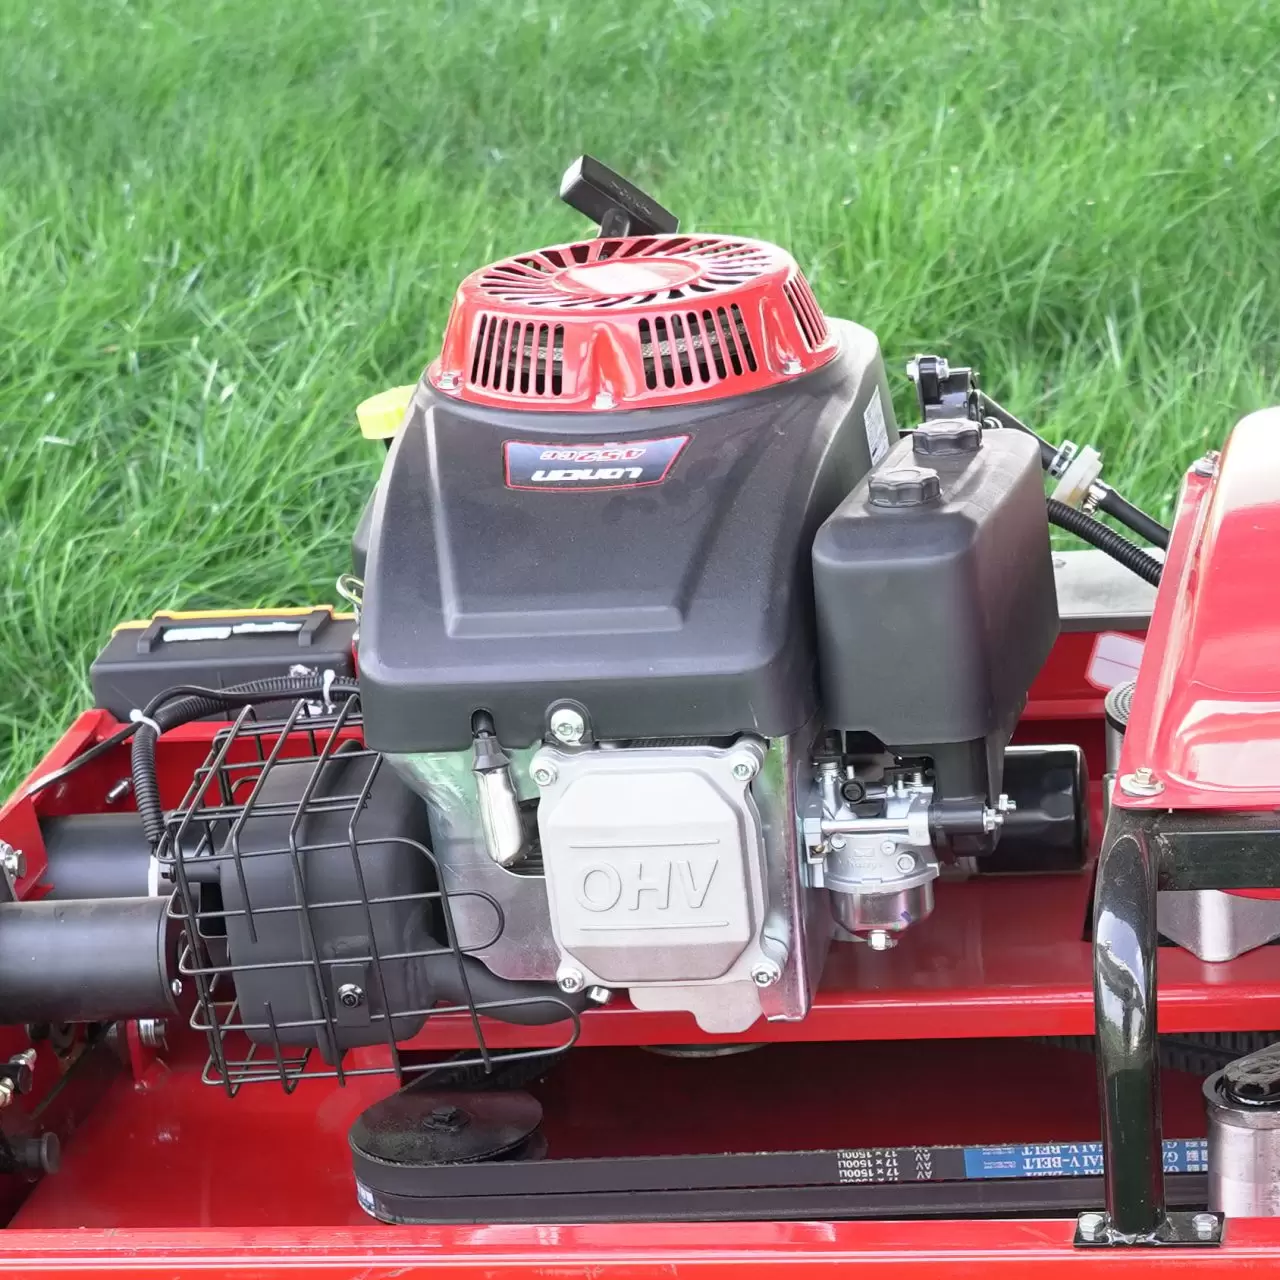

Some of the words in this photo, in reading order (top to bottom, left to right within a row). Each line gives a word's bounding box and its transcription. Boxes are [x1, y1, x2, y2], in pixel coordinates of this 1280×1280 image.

[575, 859, 721, 913] OHV
[915, 1153, 931, 1161] AV
[885, 1159, 899, 1167] 17
[916, 1162, 932, 1170] AV
[886, 1167, 900, 1176] 17
[917, 1171, 933, 1179] AV
